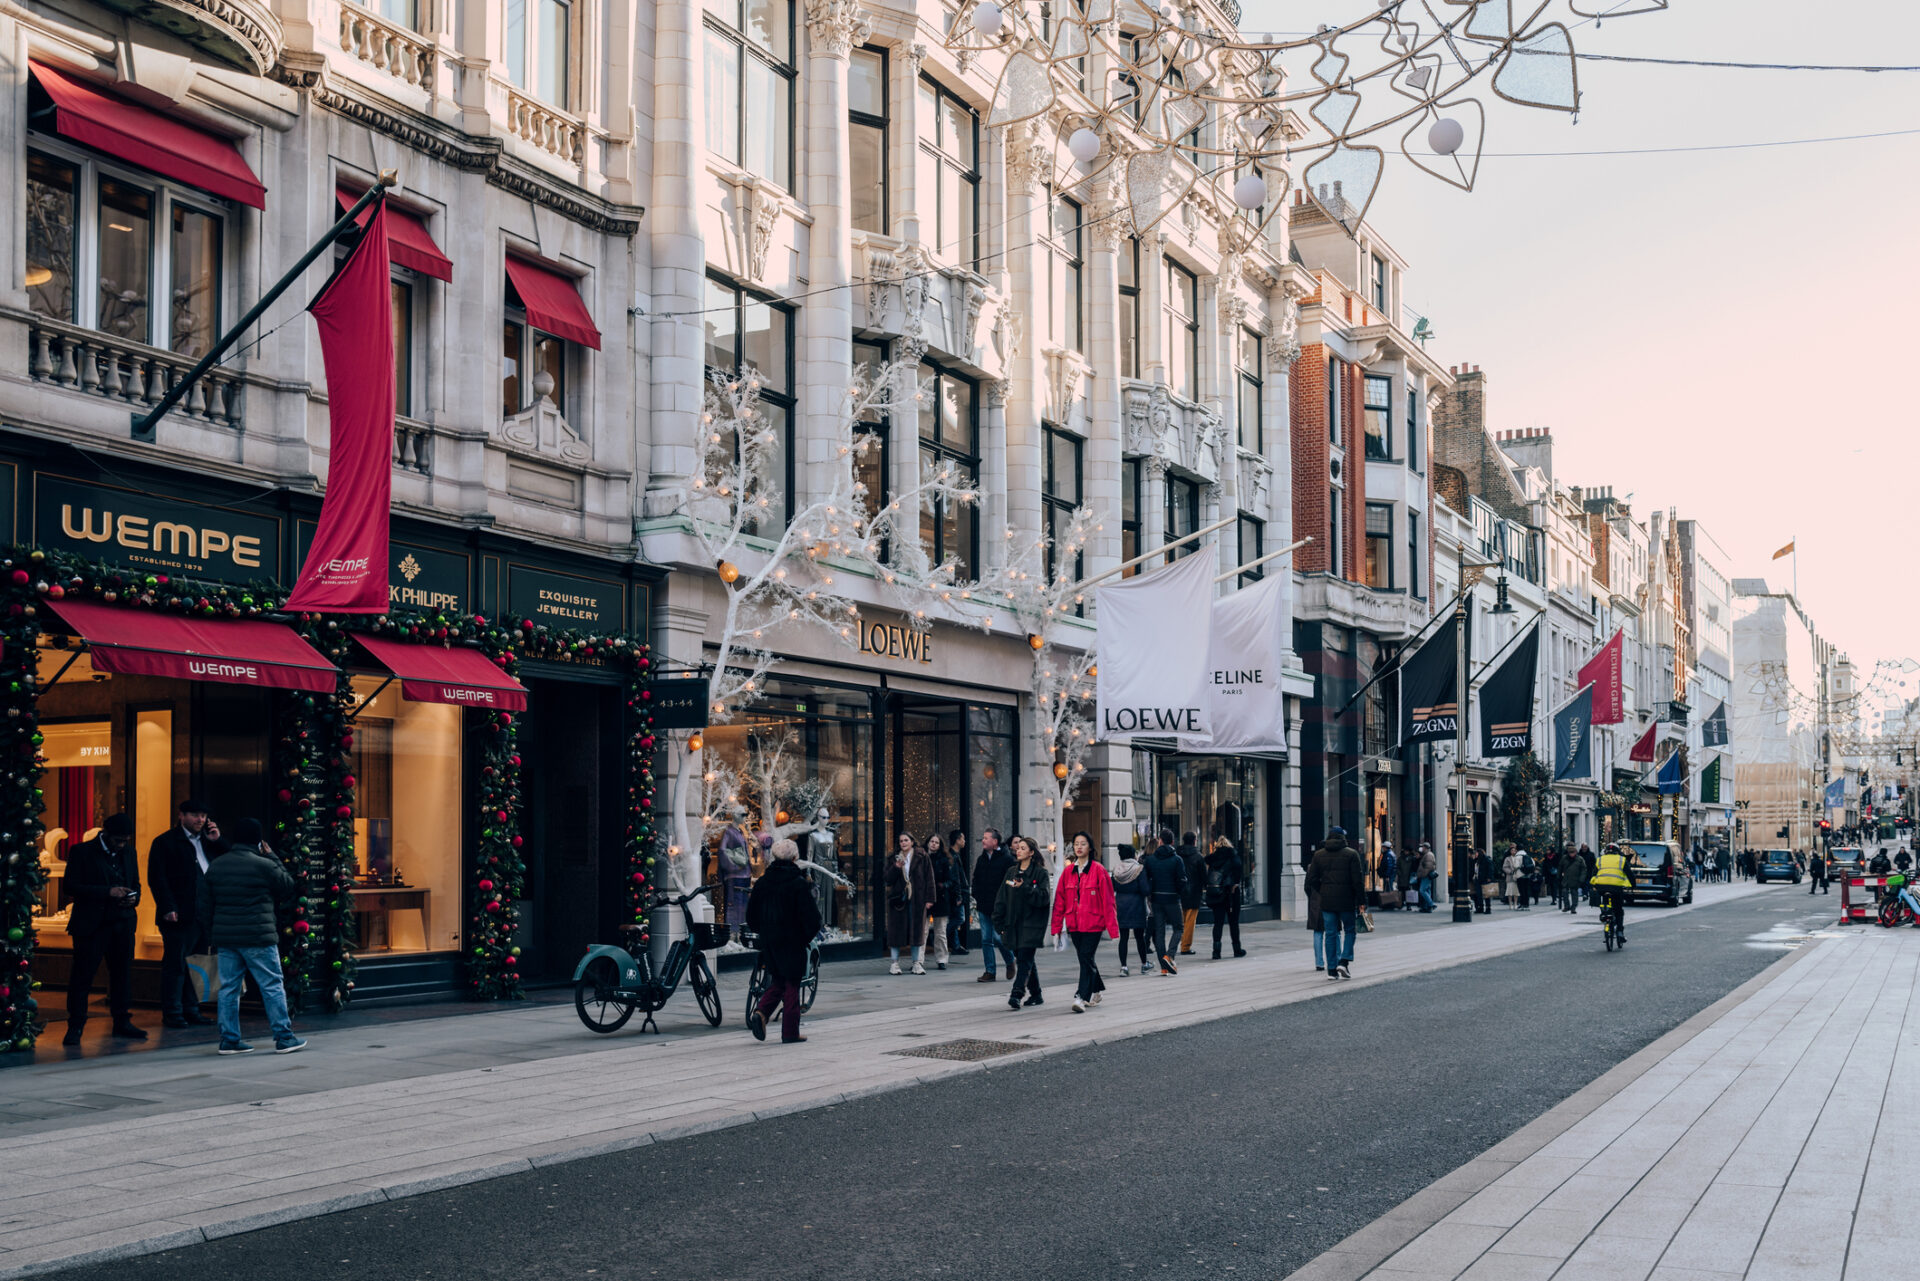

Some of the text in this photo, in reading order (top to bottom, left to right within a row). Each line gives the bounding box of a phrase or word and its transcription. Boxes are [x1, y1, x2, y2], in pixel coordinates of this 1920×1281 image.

[61, 503, 261, 568] WEMPE
[129, 554, 203, 572] ESTABLISHED 1878
[402, 587, 459, 612] PHILIPPE
[539, 589, 598, 608] EXQUISITE
[536, 603, 600, 622] JEWELLERY
[856, 618, 933, 664] LOEWE
[190, 661, 258, 678] WEMPE
[1209, 669, 1263, 685] ELINE
[1610, 647, 1620, 720] RICHARD GREEN
[443, 688, 494, 703] WEMPE
[1104, 707, 1202, 732] LOEWE
[1412, 717, 1457, 736] ZEGNA
[1491, 735, 1527, 749] ZEGN
[1115, 799, 1127, 818] 40
